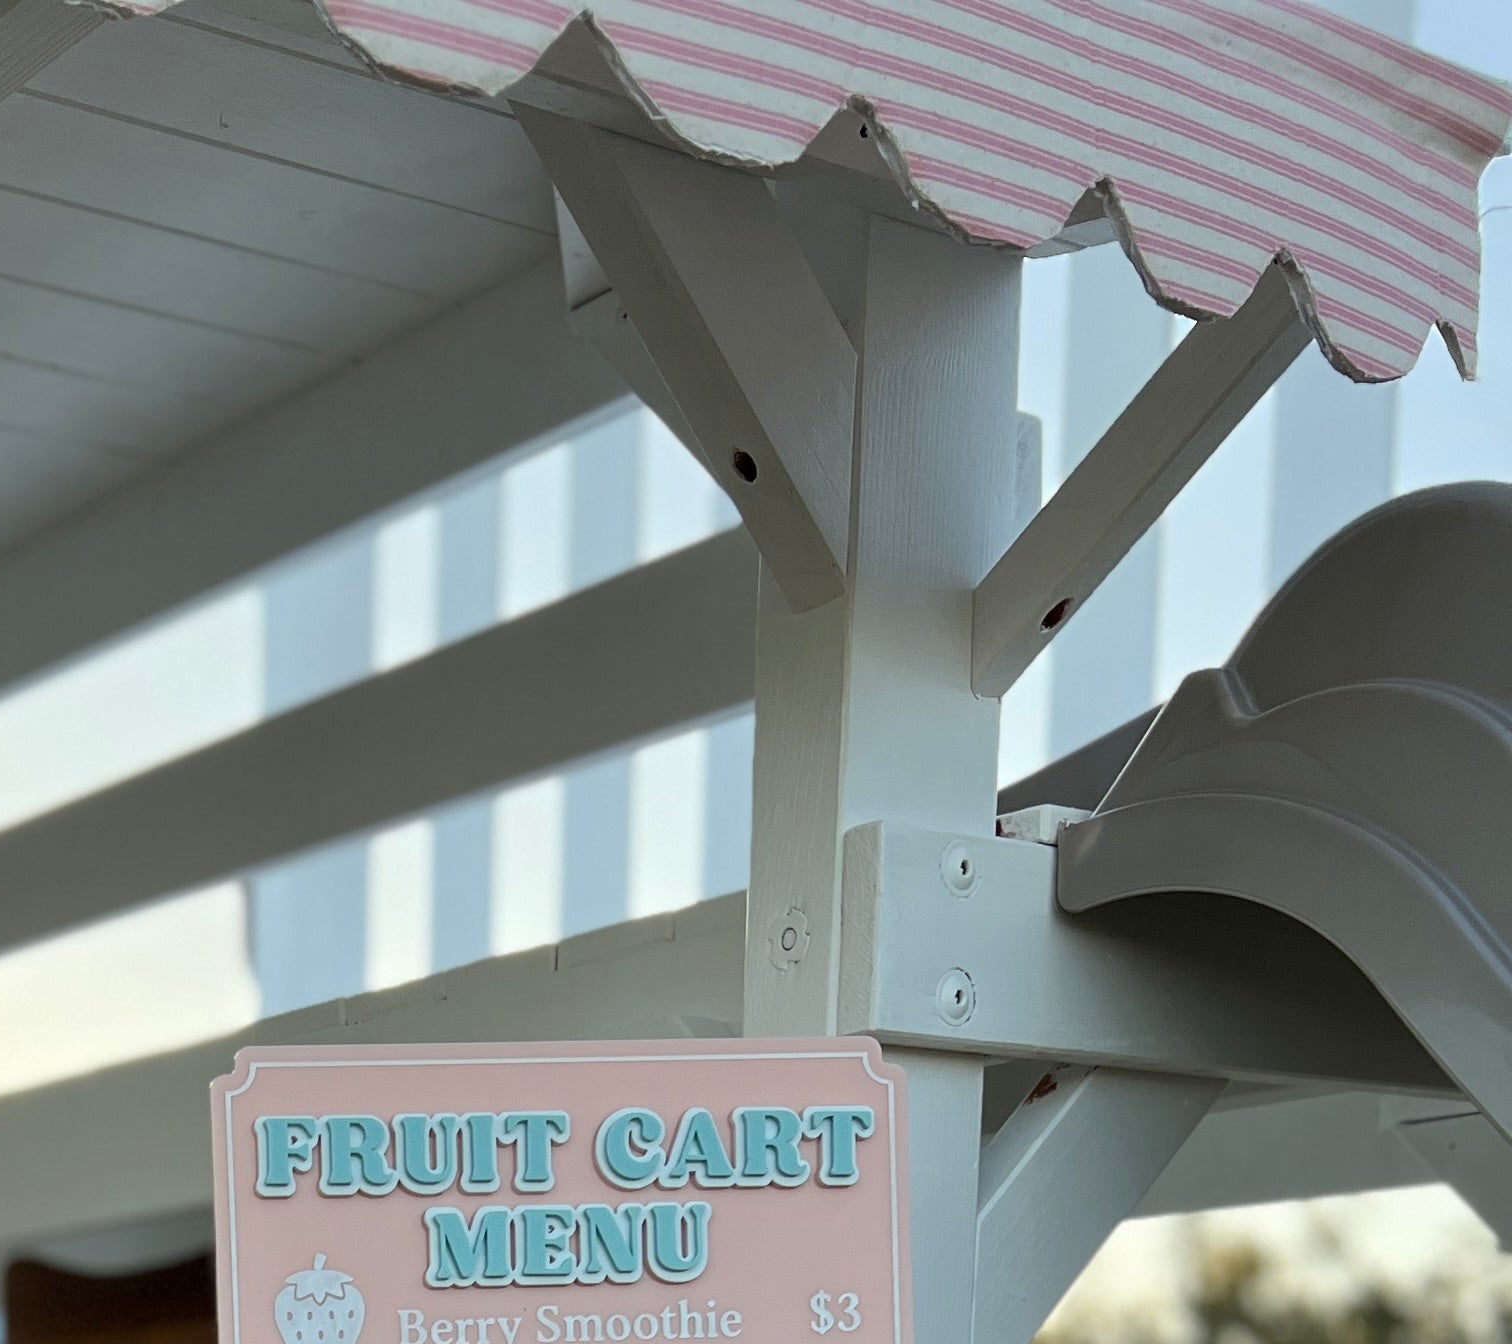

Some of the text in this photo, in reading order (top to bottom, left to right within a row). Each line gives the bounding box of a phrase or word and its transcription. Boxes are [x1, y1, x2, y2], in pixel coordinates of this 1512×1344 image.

[255, 1106, 875, 1197] FRUIT CART
[424, 1201, 712, 1287] MENU
[536, 1299, 743, 1344] Smoothie
[809, 1289, 862, 1335] $3
